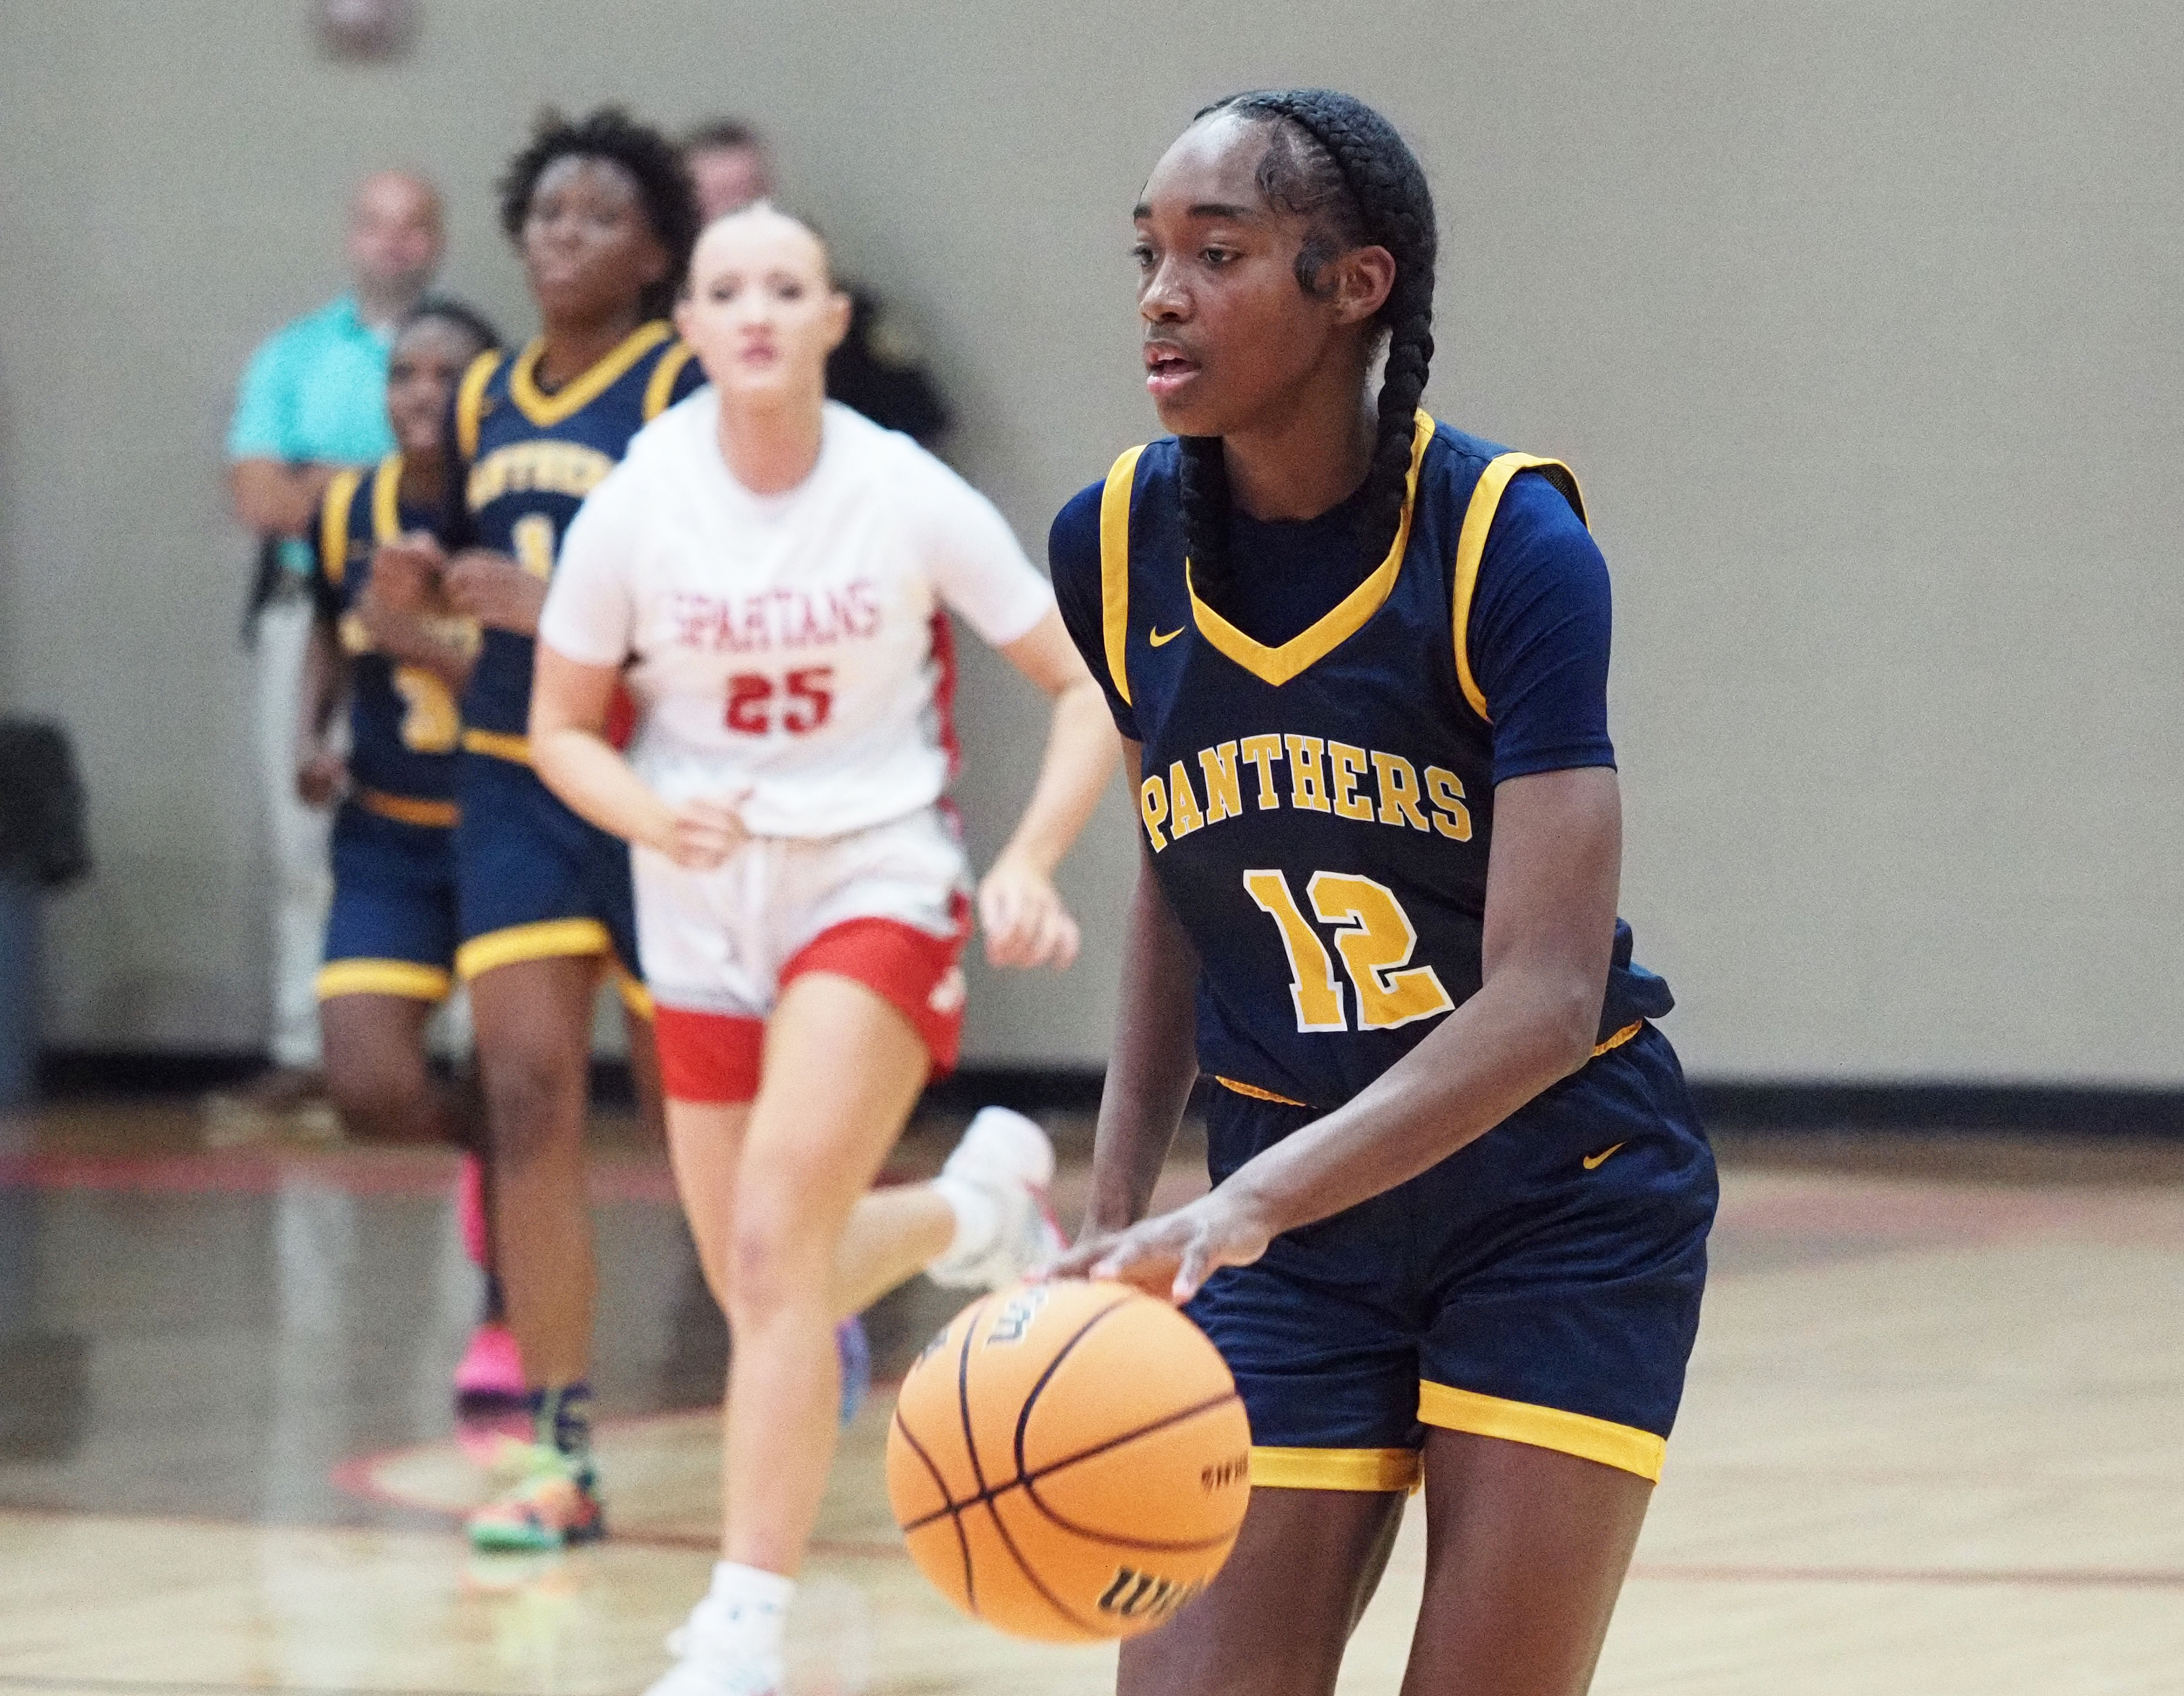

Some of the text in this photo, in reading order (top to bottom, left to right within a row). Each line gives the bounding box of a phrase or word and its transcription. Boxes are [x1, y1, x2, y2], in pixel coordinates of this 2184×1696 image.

[672, 577, 882, 654] SPARTANS
[724, 664, 834, 734] 25
[1141, 733, 1473, 853] PANTHERS
[1243, 869, 1456, 1033] 12
